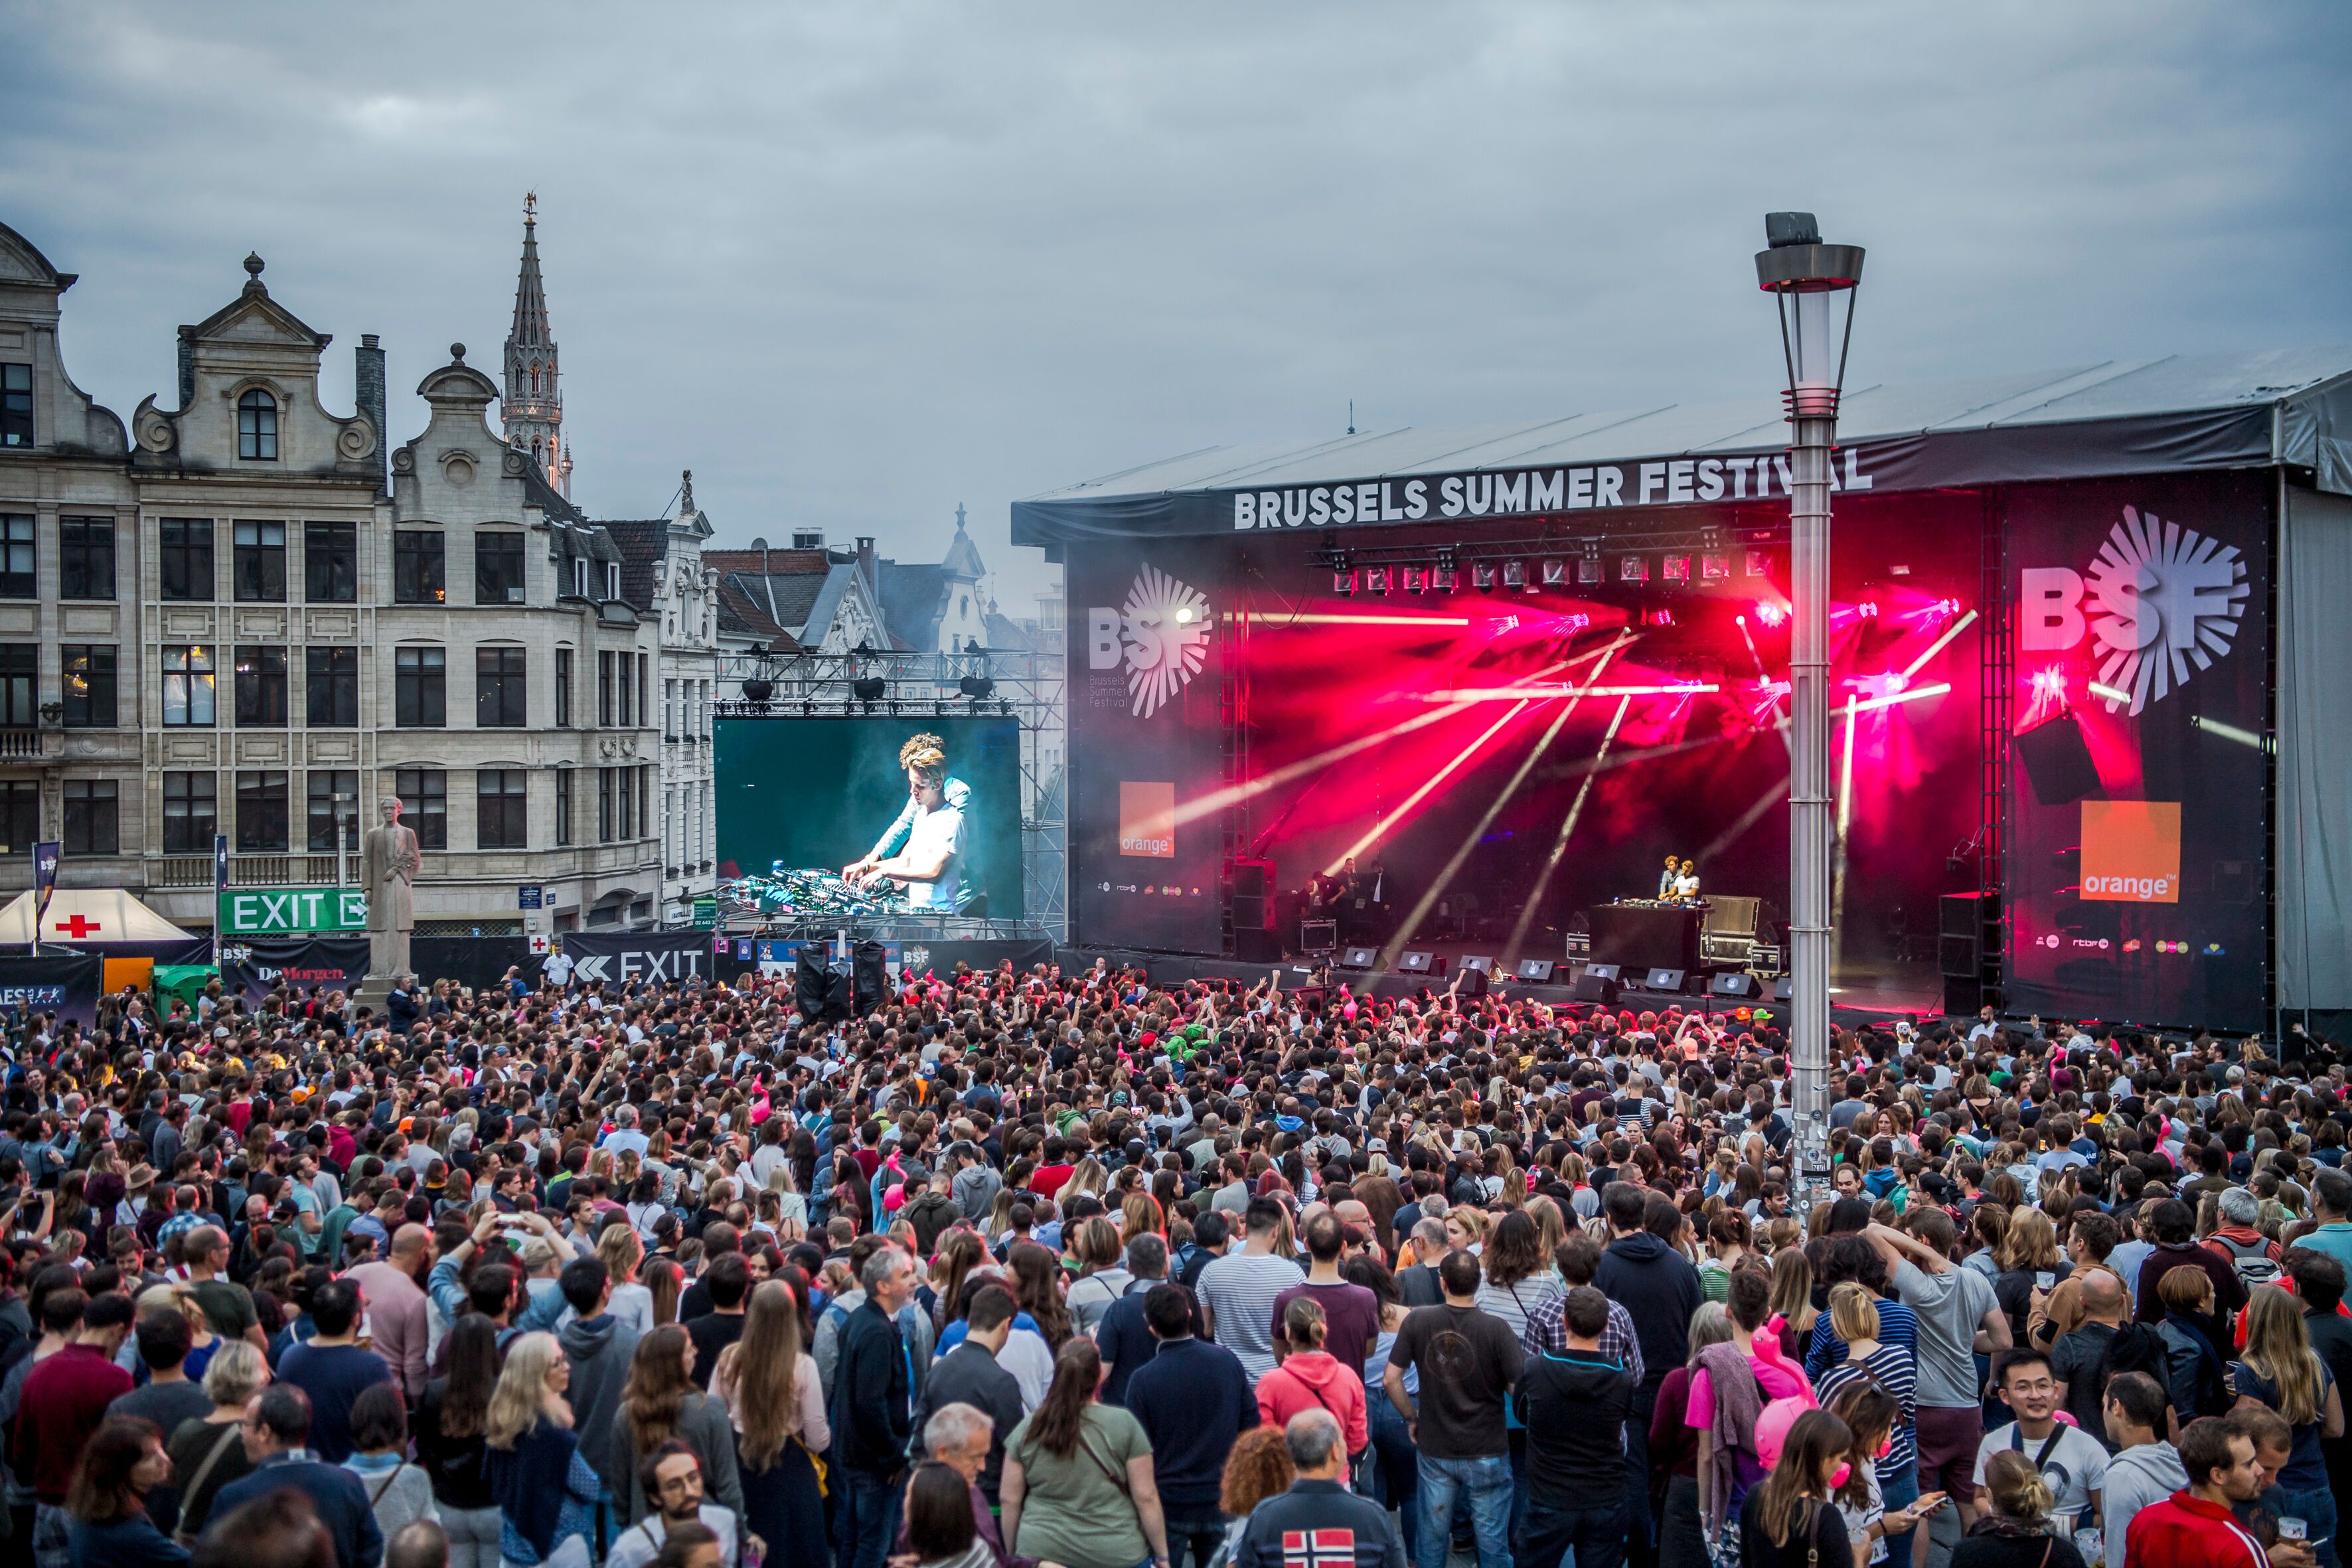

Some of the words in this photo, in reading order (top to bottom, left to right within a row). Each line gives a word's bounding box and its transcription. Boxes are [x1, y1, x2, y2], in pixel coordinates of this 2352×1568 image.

[1234, 480, 1428, 530] BRUSSELS
[1440, 467, 1624, 517] SUMMER
[2021, 562, 2233, 651] BSF
[1089, 602, 1203, 670] BSF
[1089, 674, 1125, 685] Brussels
[1089, 686, 1127, 696] Summer
[1089, 696, 1128, 708] Festival
[1122, 838, 1168, 854] orange
[40, 860, 56, 870] BSF
[2084, 873, 2168, 898] orange
[234, 894, 324, 929] EXIT
[223, 948, 252, 960] BSF
[903, 951, 929, 963] BSF
[621, 950, 703, 984] EXIT
